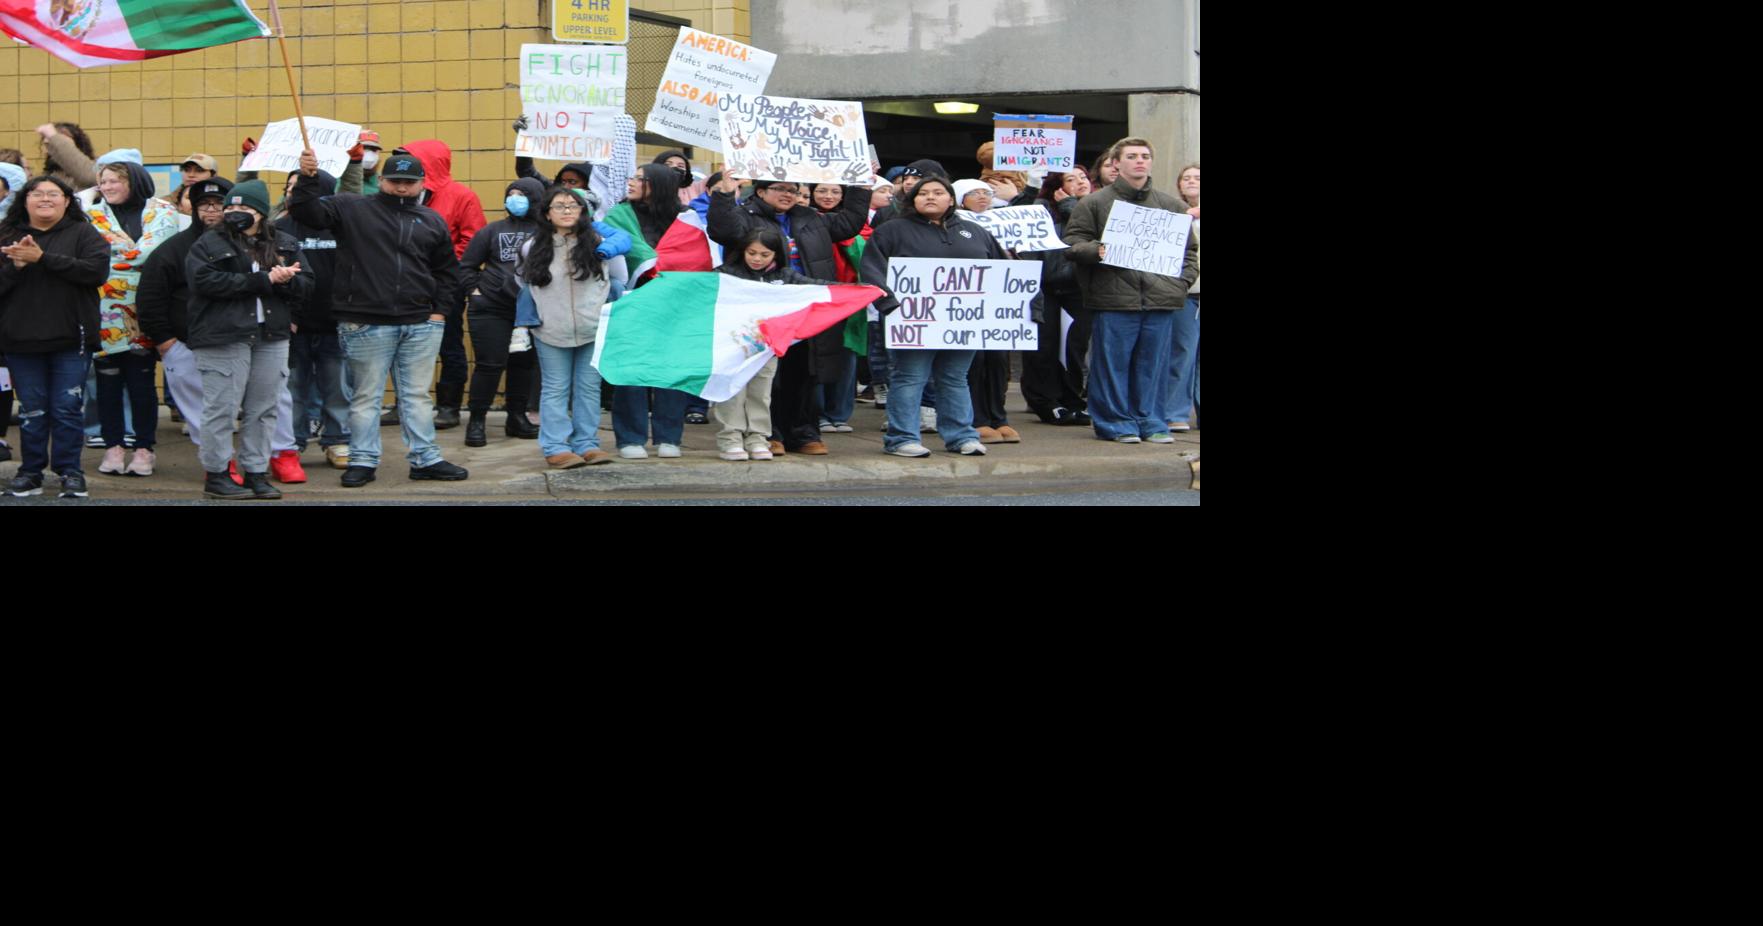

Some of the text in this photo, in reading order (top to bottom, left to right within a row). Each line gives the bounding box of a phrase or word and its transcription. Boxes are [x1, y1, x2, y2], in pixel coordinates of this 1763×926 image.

[571, 0, 610, 11] 4 HR
[571, 12, 609, 23] PARKING
[563, 24, 617, 36] UPPER LEVEL
[681, 31, 752, 62] AMERICA:
[528, 53, 624, 77] FIGHT
[675, 51, 701, 67] Hates
[521, 82, 625, 107] IGNORANCE
[661, 80, 700, 100] ALSO
[719, 93, 811, 124] My People,
[536, 111, 594, 132] NOT
[746, 116, 780, 144] My
[1001, 136, 1064, 146] IGNORANCE
[1013, 129, 1046, 138] FEAR
[774, 138, 802, 165] My
[802, 140, 851, 168] Fight
[1023, 146, 1047, 156] NOT
[992, 208, 1051, 221] HUMAN
[1130, 206, 1177, 228] FIGHT
[1026, 221, 1049, 239] IS
[1106, 218, 1186, 247] IGNORANCE
[1132, 237, 1159, 251] NOT
[891, 265, 921, 294] You
[1003, 267, 1037, 294] love
[900, 296, 1024, 322] OUR food and
[890, 323, 1037, 350] NOT our people.
